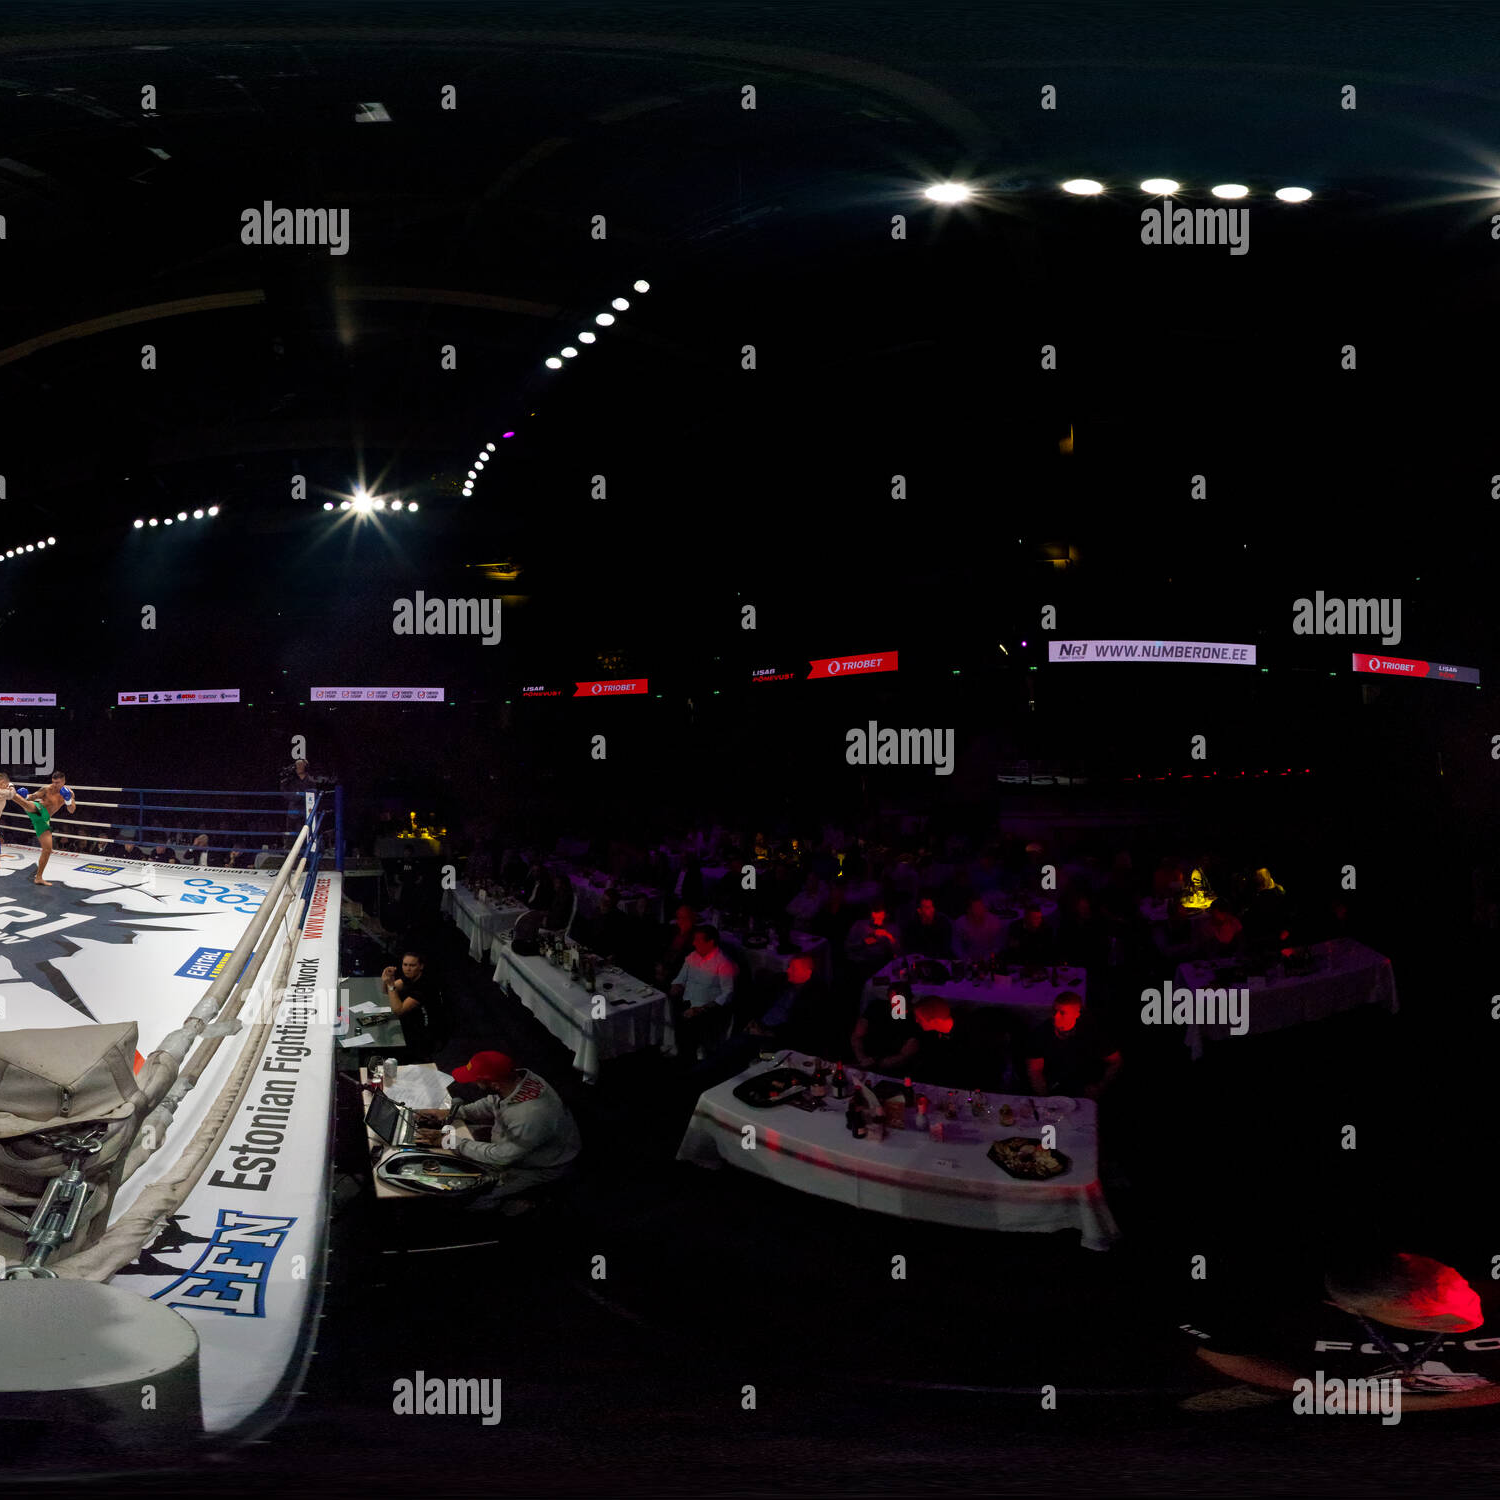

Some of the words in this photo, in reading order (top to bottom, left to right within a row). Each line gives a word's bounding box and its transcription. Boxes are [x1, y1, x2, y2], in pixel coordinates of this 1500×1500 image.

[1095, 645, 1248, 661] WWW.NUMBERONE.EE
[752, 668, 776, 676] LISAB
[842, 658, 883, 671] TRIOBET
[1382, 661, 1415, 672] TRIOBET
[603, 684, 636, 692] TRIOBET
[303, 878, 331, 940] WWW.NUMBERONE.EE
[186, 951, 222, 977] EHITAL
[207, 1083, 296, 1192] Estonian
[263, 1003, 317, 1072] Fighting
[293, 957, 320, 1014] Network
